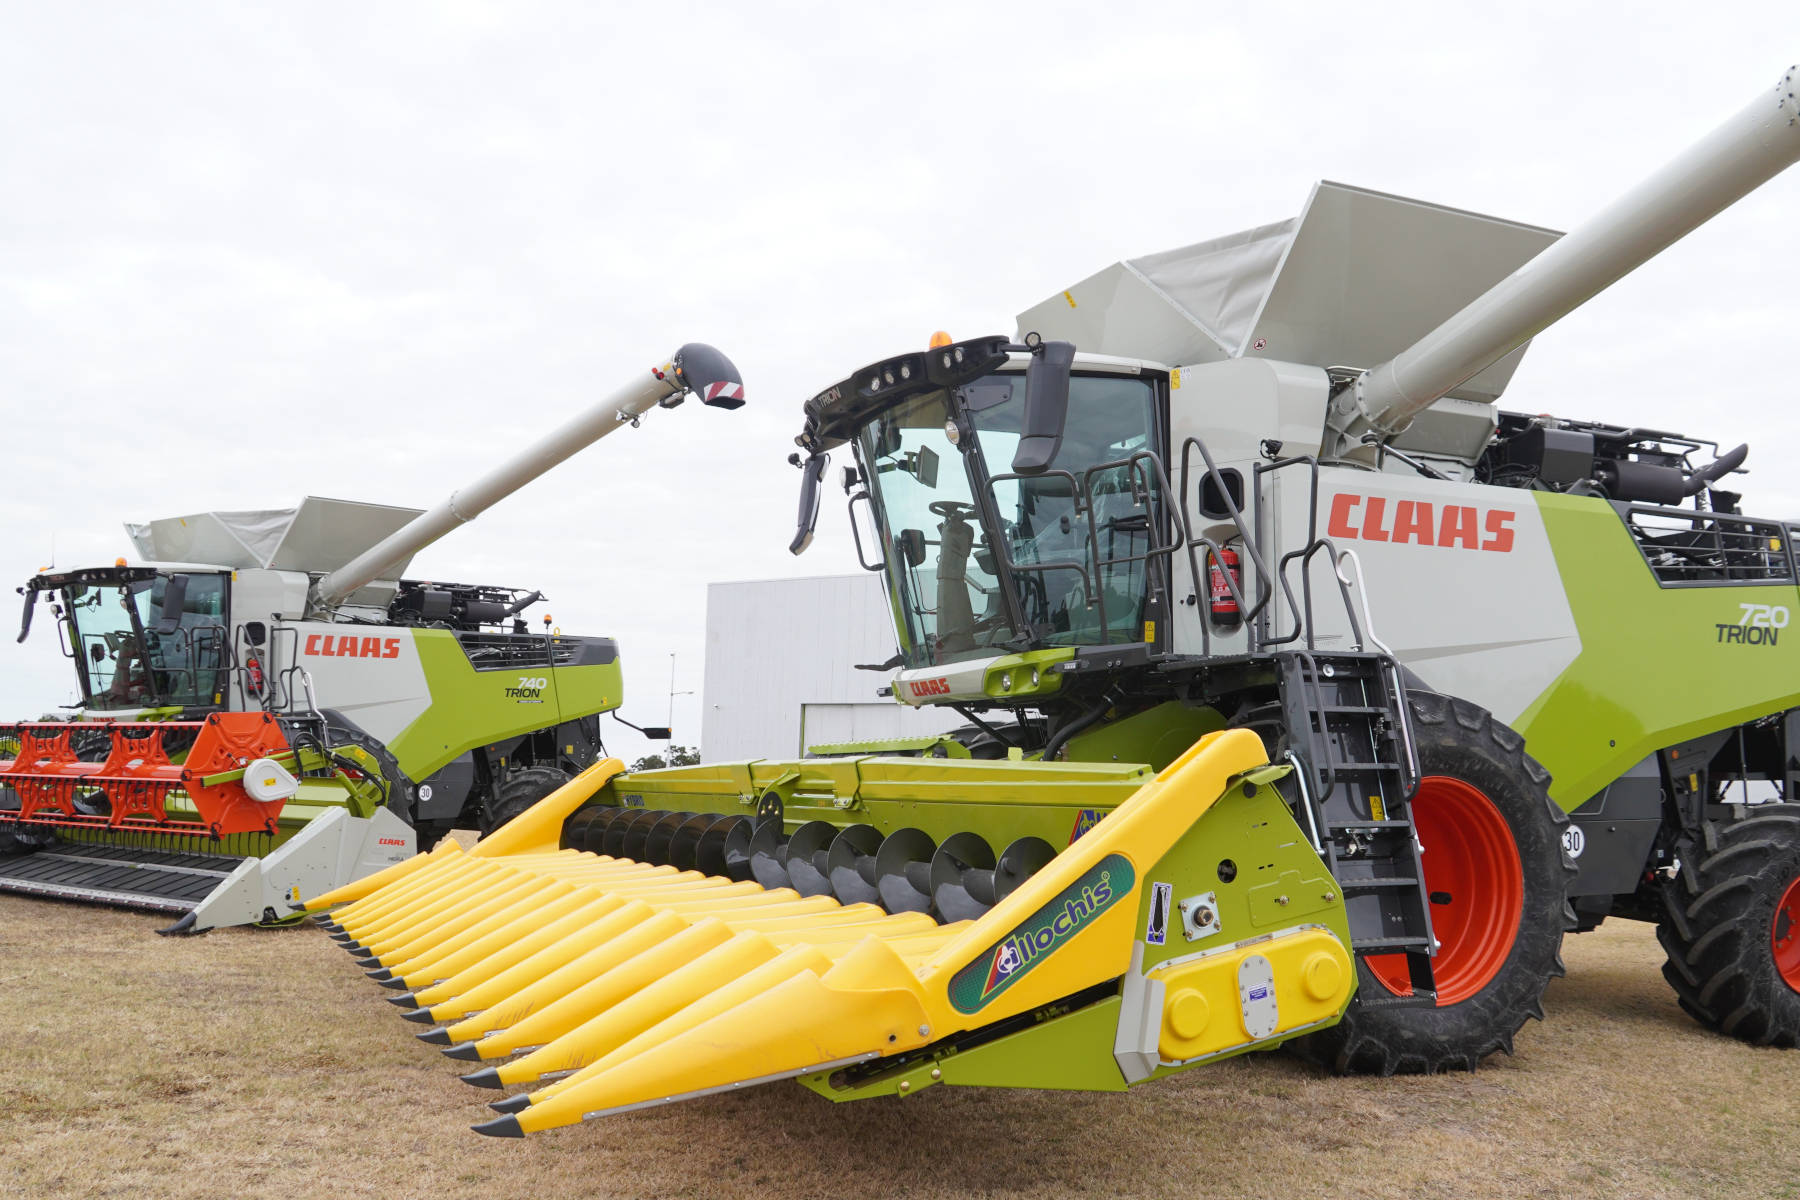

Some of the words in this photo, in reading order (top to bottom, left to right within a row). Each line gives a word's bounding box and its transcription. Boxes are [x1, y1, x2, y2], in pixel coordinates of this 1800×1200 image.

[1328, 493, 1515, 552] CLAAS
[1738, 603, 1789, 628] 720
[1715, 624, 1778, 646] TRION
[304, 634, 400, 658] CLAAS
[504, 688, 540, 698] TRION
[518, 677, 547, 689] 740
[421, 788, 430, 798] 30
[379, 838, 405, 846] CLAAS
[1564, 831, 1580, 852] 30
